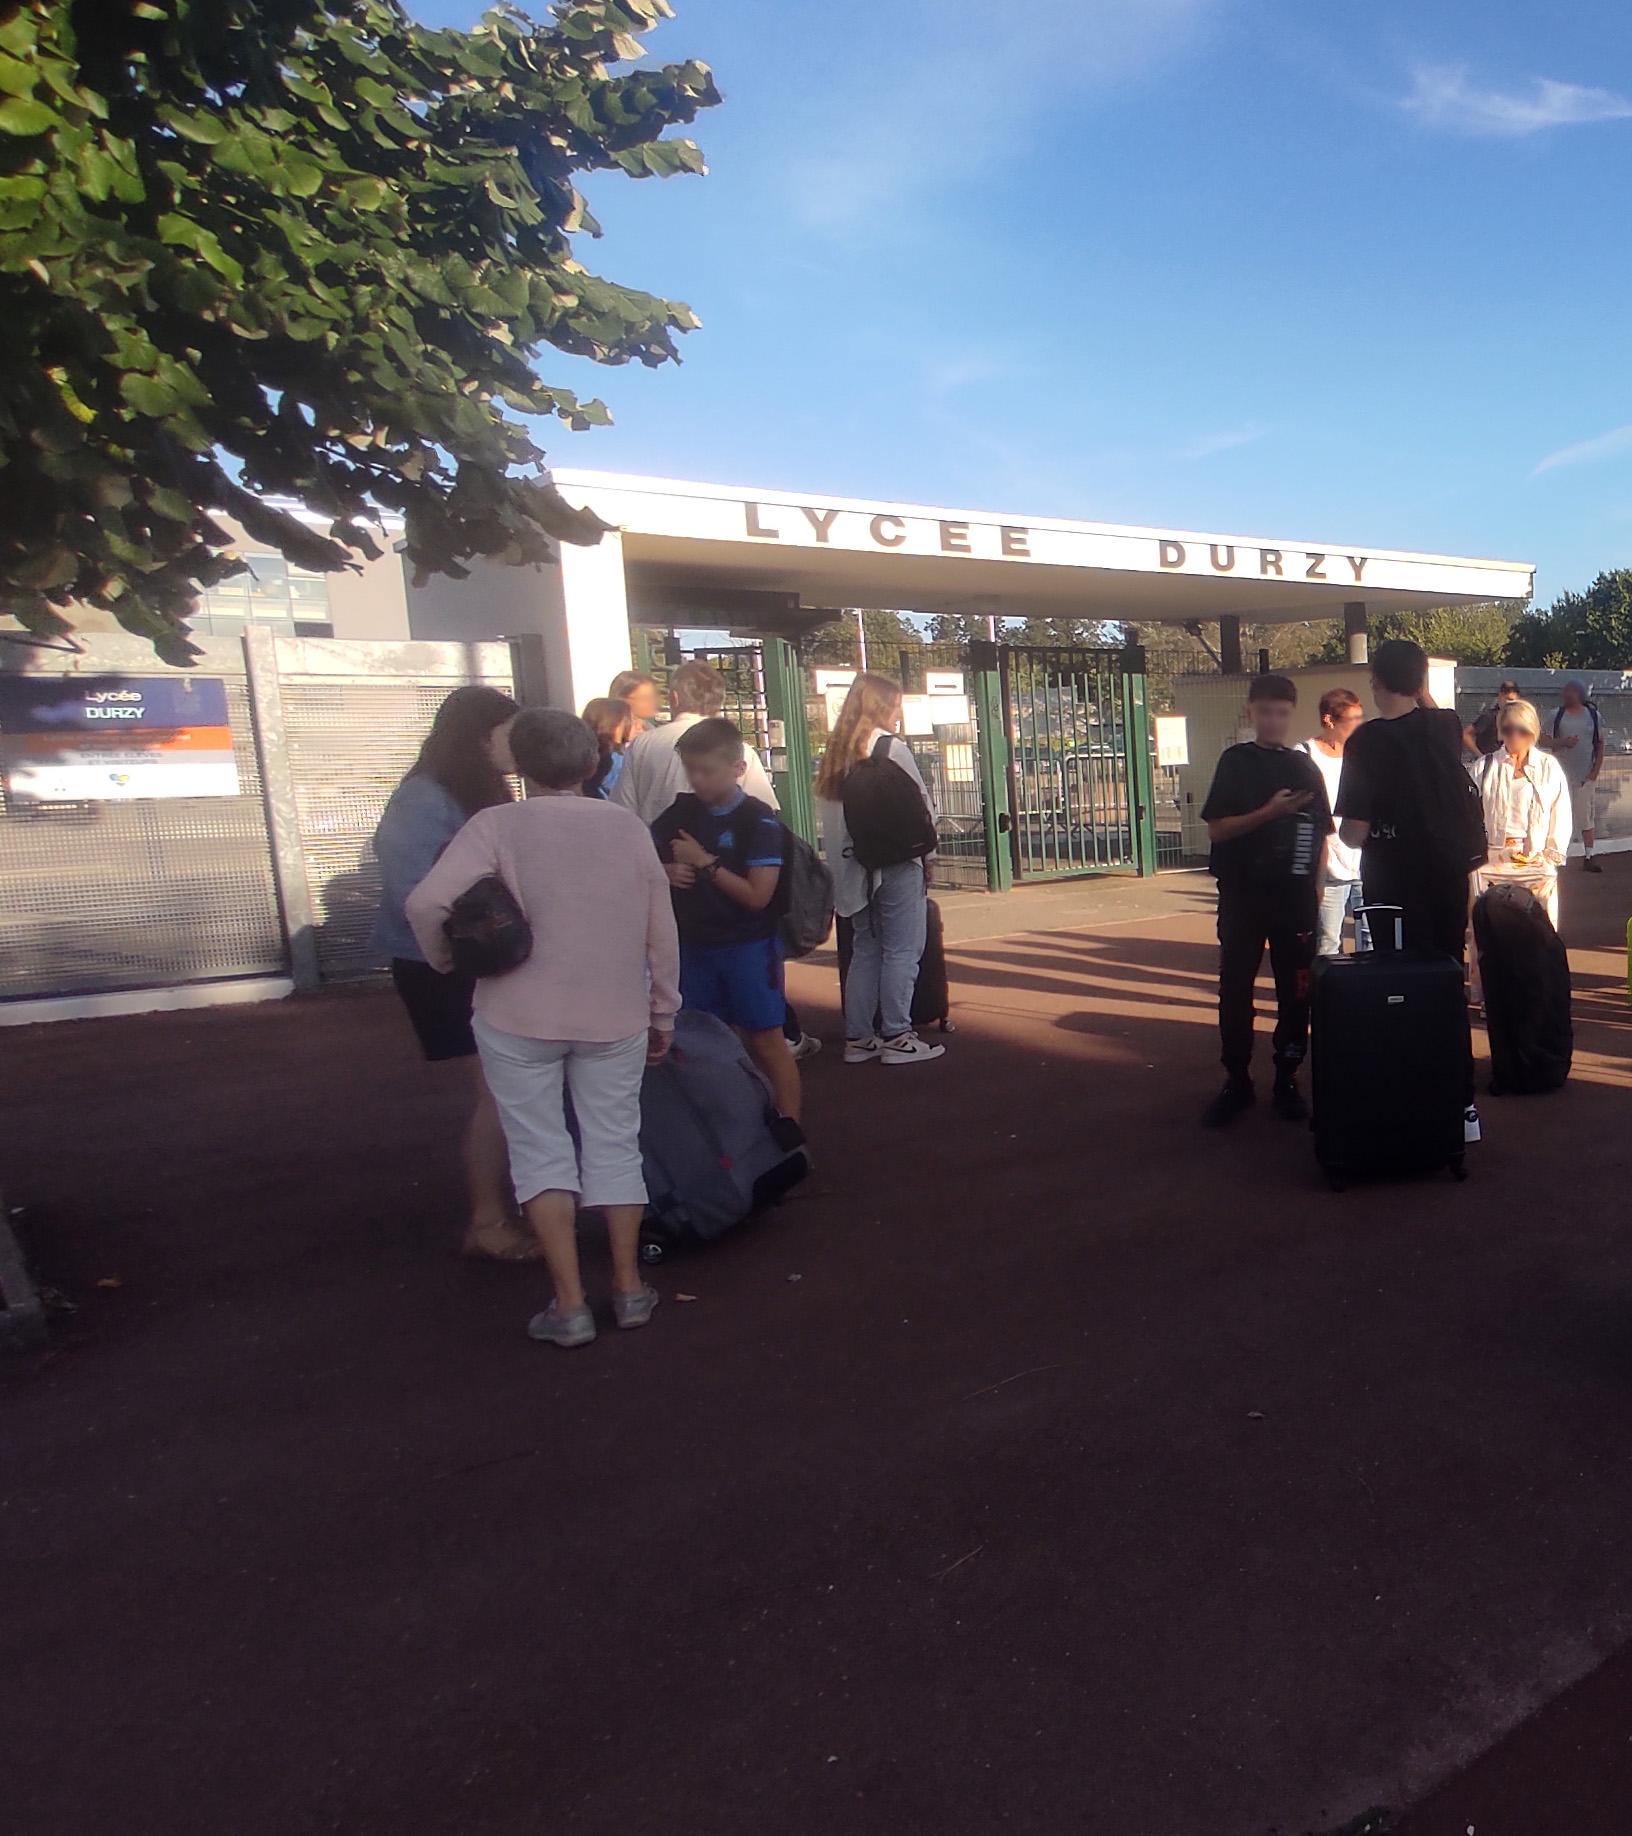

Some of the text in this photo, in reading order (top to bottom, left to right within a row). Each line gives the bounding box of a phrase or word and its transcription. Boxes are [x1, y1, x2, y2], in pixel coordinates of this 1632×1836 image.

[744, 501, 1368, 582] LYCEE DURZY
[85, 690, 141, 703] Lycée
[86, 707, 145, 719] DURZY
